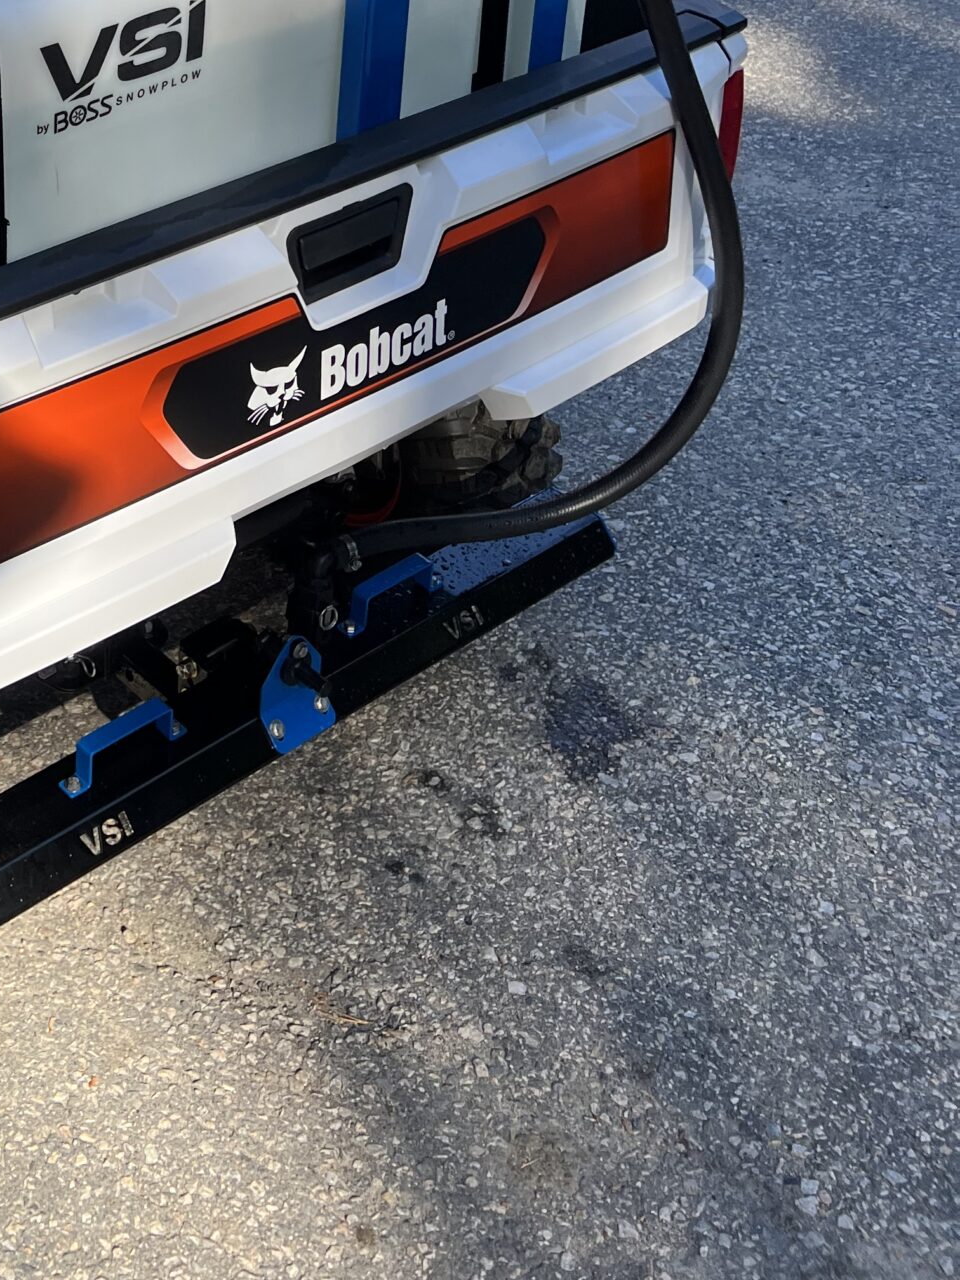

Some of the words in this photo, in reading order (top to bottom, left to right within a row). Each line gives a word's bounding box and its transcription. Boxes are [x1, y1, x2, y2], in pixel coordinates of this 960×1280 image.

[36, 123, 50, 135] by
[53, 94, 114, 134] BOSS
[115, 69, 202, 106] SNOWPLOW
[320, 298, 449, 401] Bobcat
[442, 605, 484, 640] VSI
[80, 810, 134, 856] VSI
